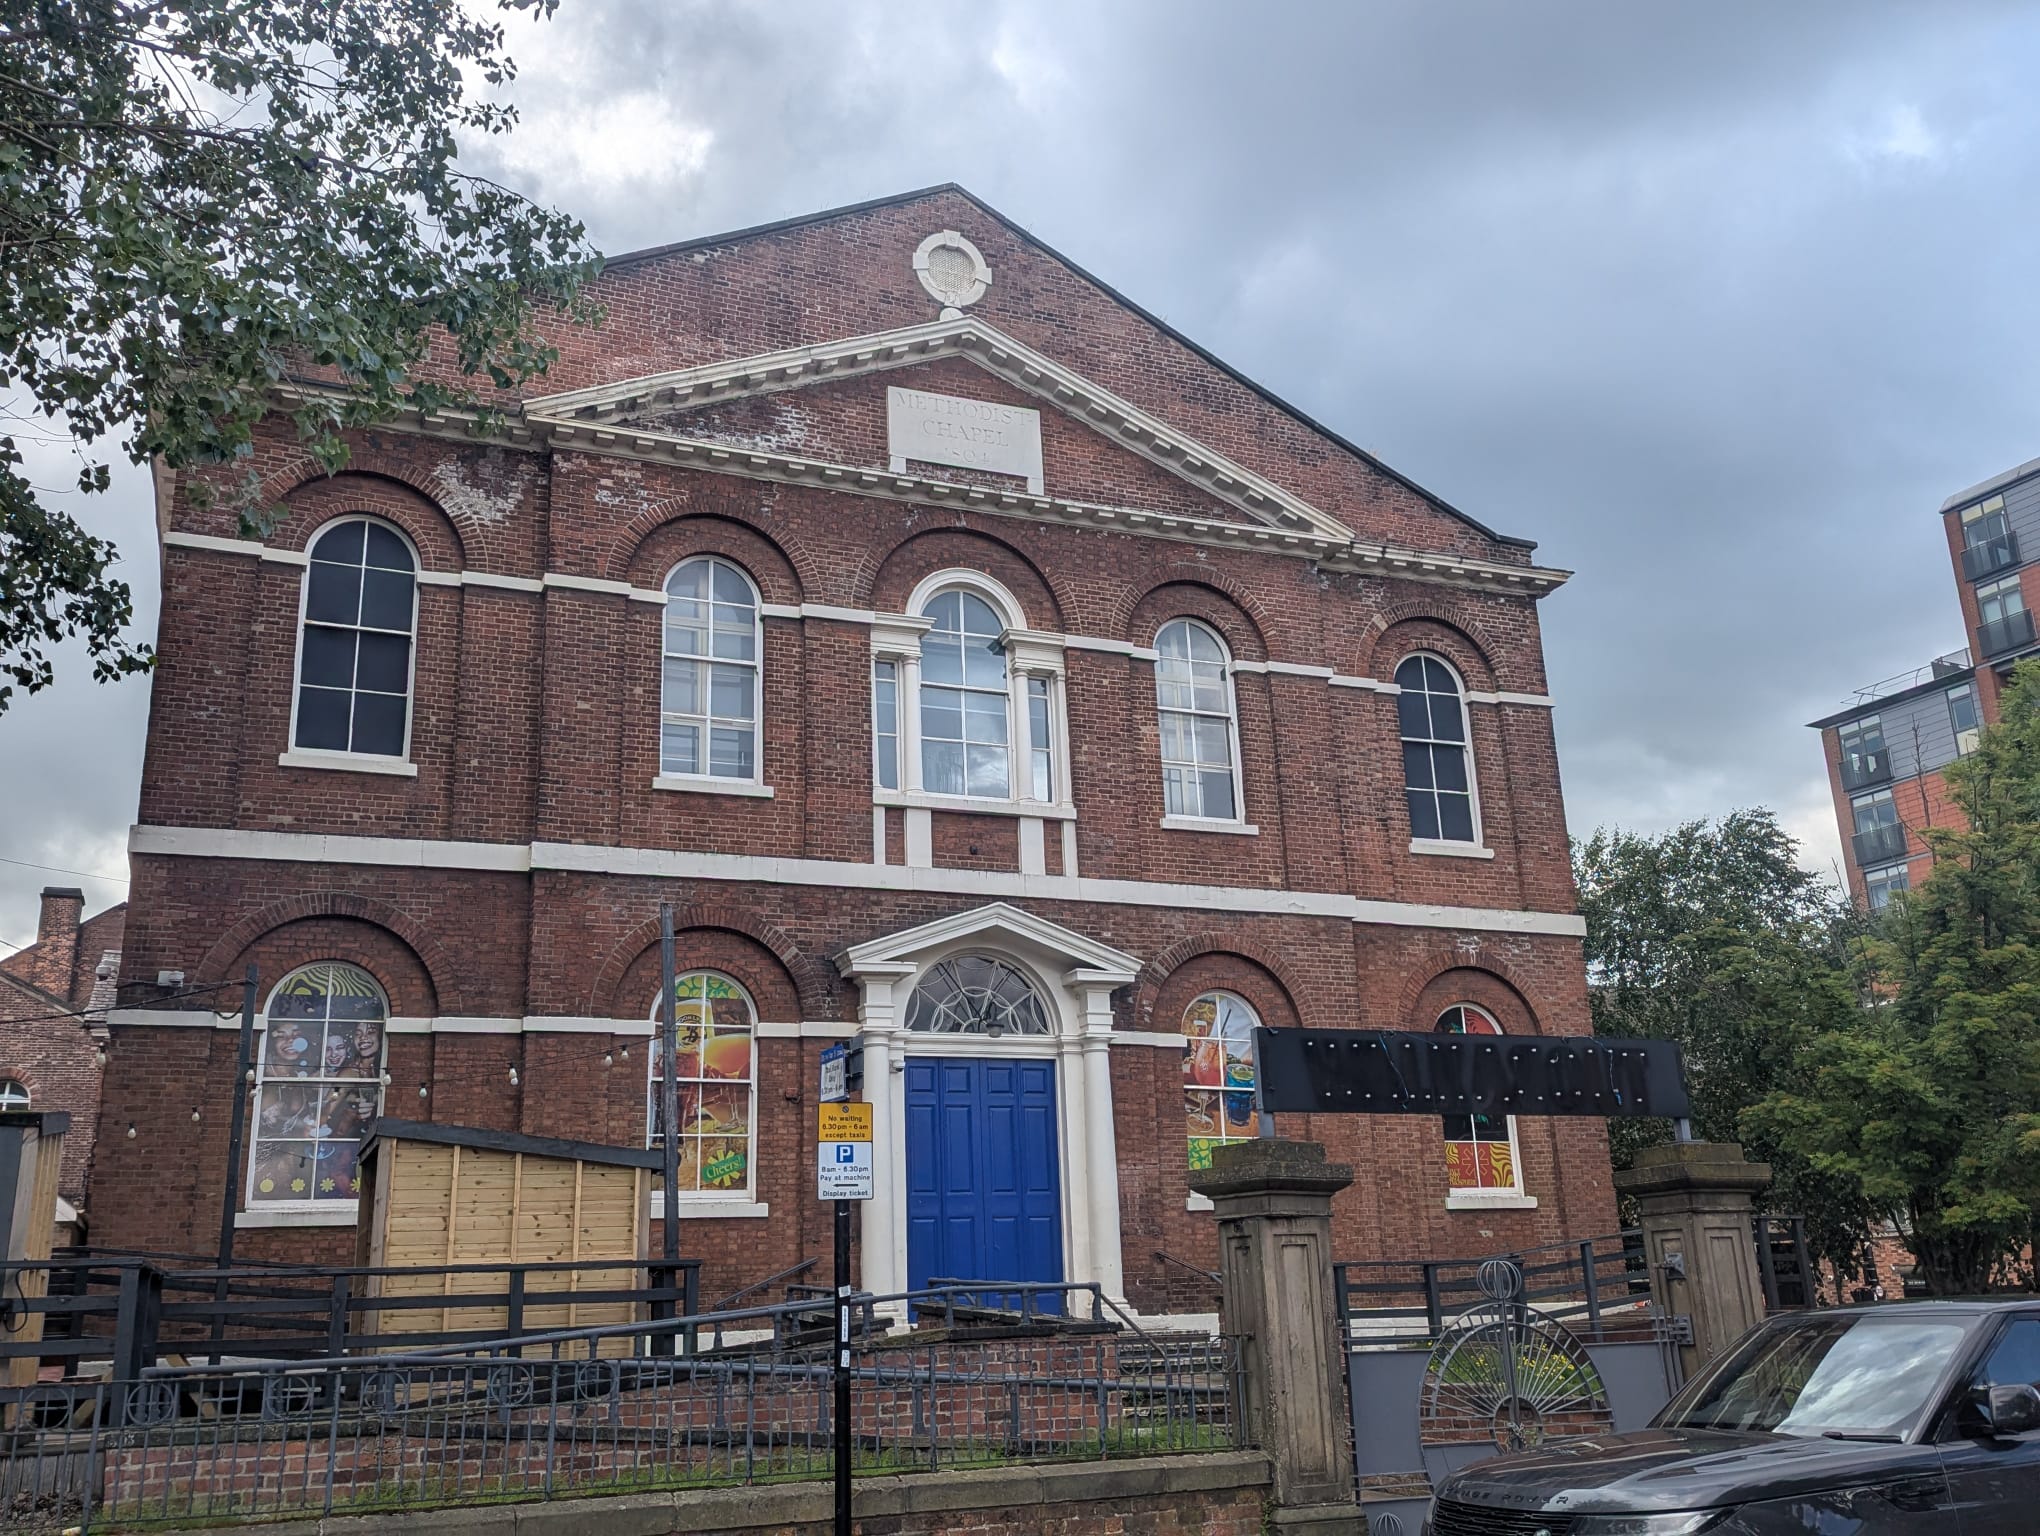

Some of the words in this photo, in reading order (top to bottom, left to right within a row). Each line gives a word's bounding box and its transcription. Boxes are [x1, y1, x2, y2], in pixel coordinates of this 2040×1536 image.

[922, 418, 1008, 446] CHAPEL
[840, 1146, 851, 1162] P
[706, 1154, 741, 1178] Cheers!
[820, 1174, 832, 1182] Pay
